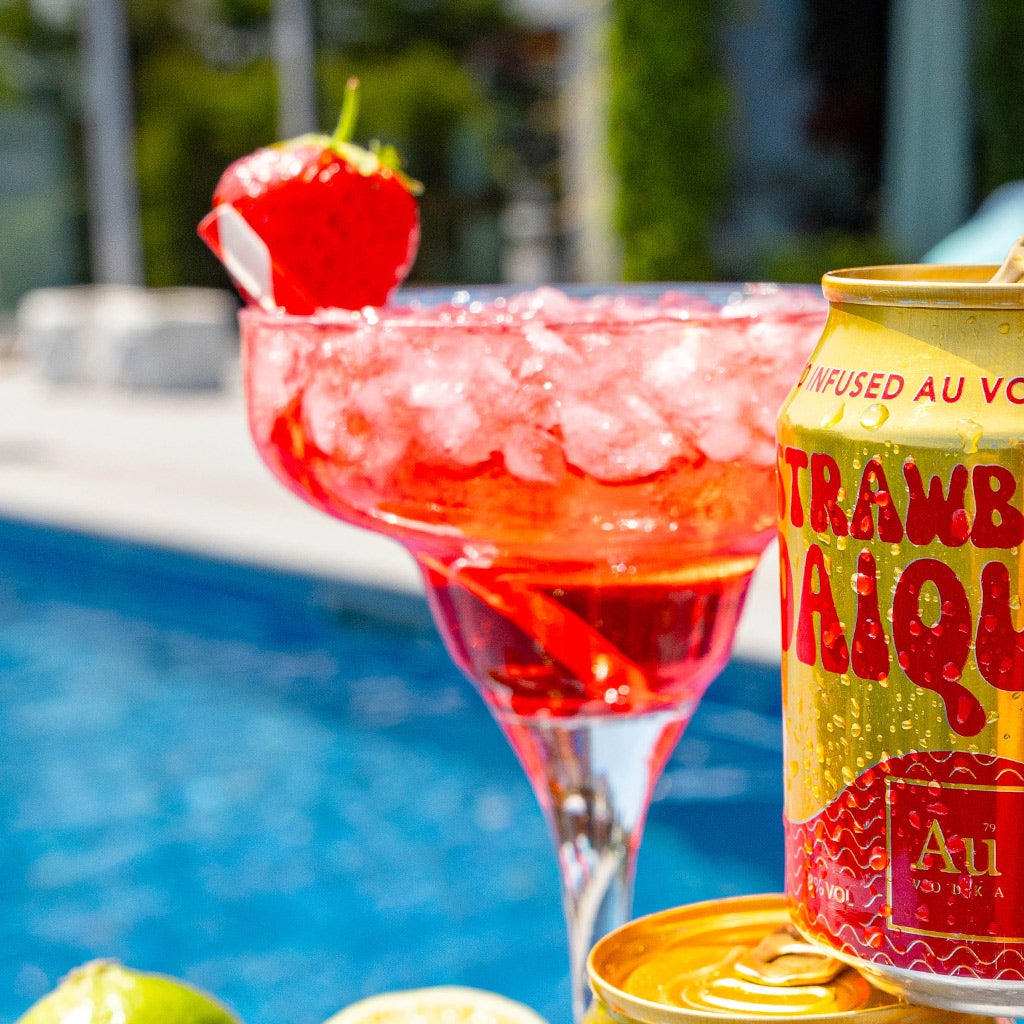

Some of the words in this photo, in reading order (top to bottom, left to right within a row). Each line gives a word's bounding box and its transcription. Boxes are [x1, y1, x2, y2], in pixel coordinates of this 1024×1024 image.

[805, 366, 905, 400] INFUSED
[913, 376, 964, 404] AU
[983, 822, 997, 834] 79
[915, 818, 1002, 877] Au
[825, 881, 854, 907] VOL
